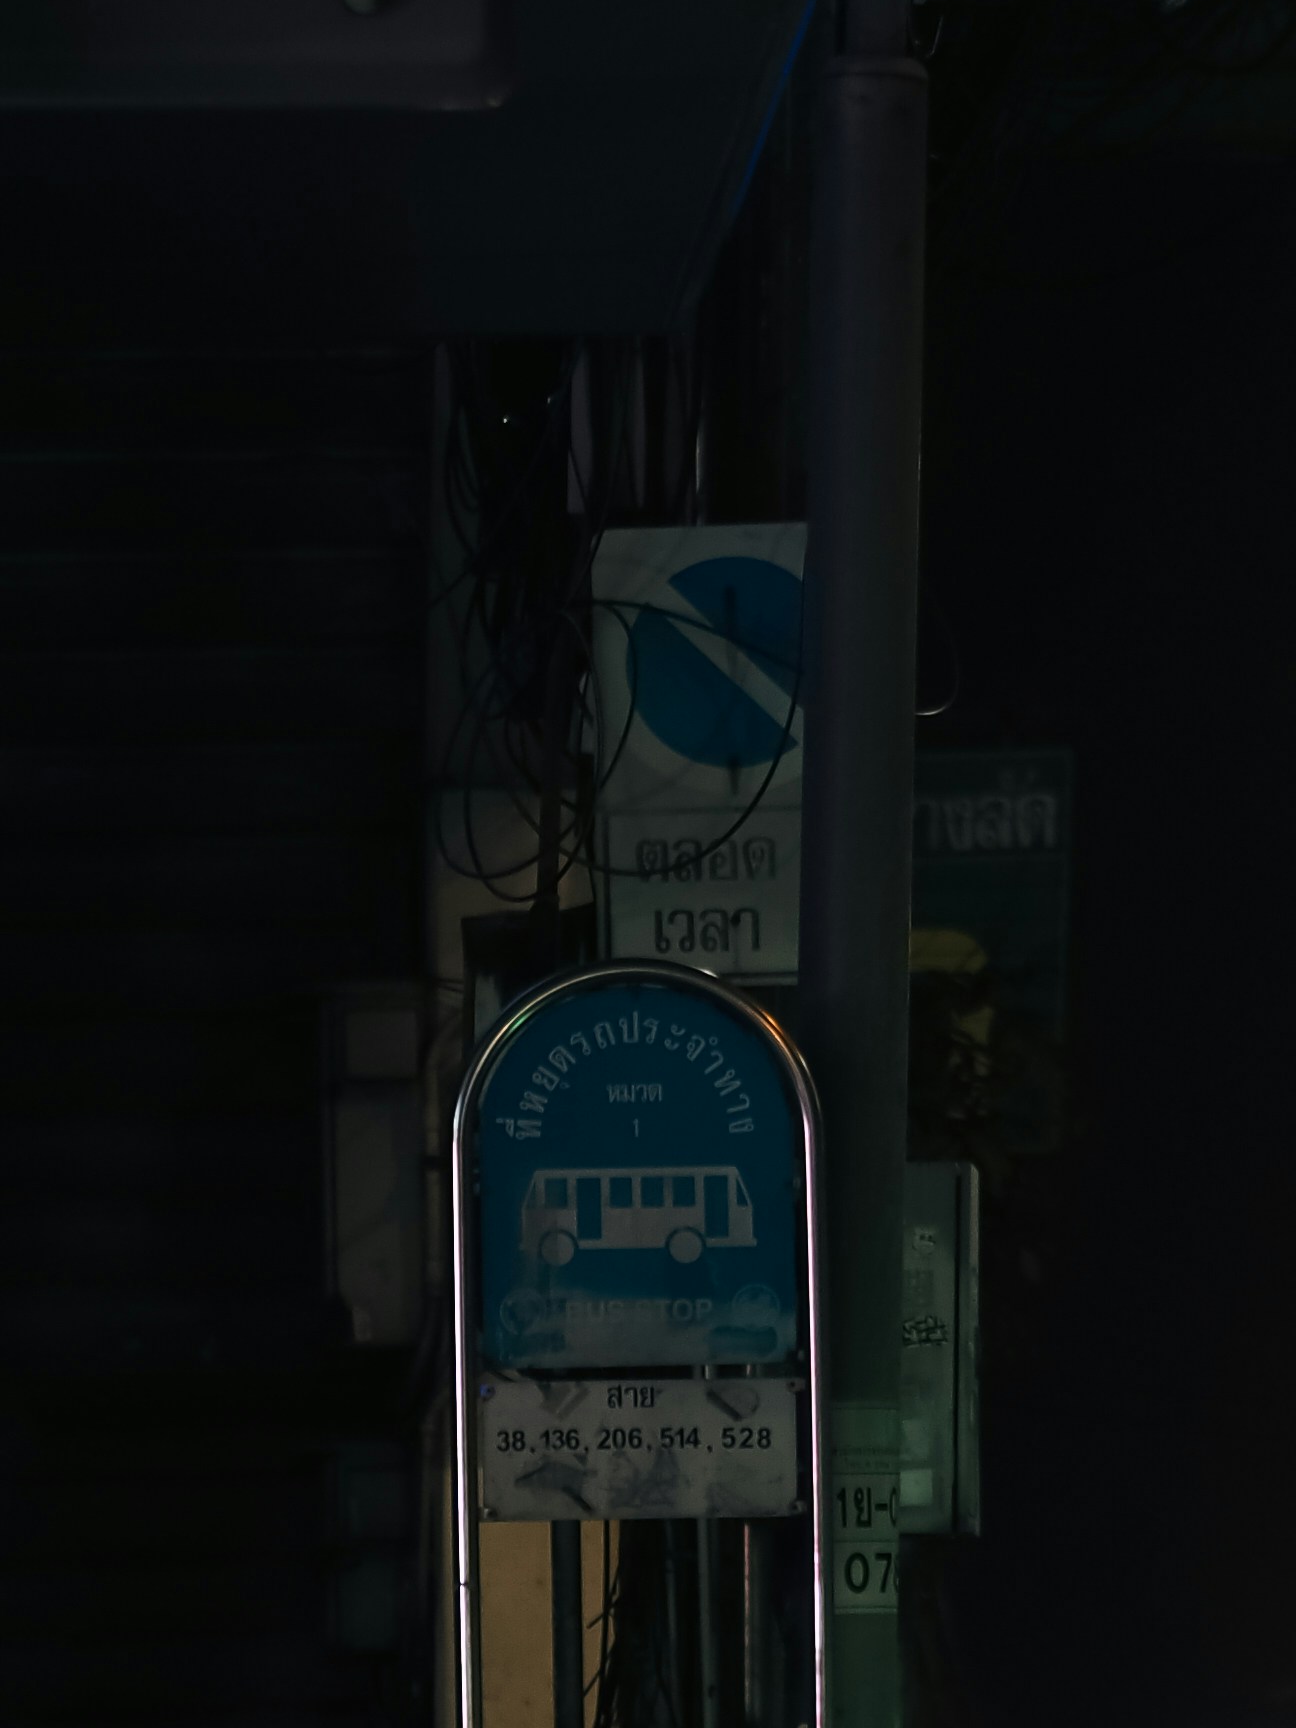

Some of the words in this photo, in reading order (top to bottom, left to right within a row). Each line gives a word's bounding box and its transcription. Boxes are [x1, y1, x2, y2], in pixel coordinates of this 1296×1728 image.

[635, 834, 777, 882] ตลอด
[654, 904, 761, 953] เวลา
[606, 1079, 664, 1105] หมวด
[631, 1118, 640, 1138] 1
[607, 1385, 656, 1410] สาย
[722, 1427, 772, 1450] 528
[845, 1552, 899, 1594] 07
